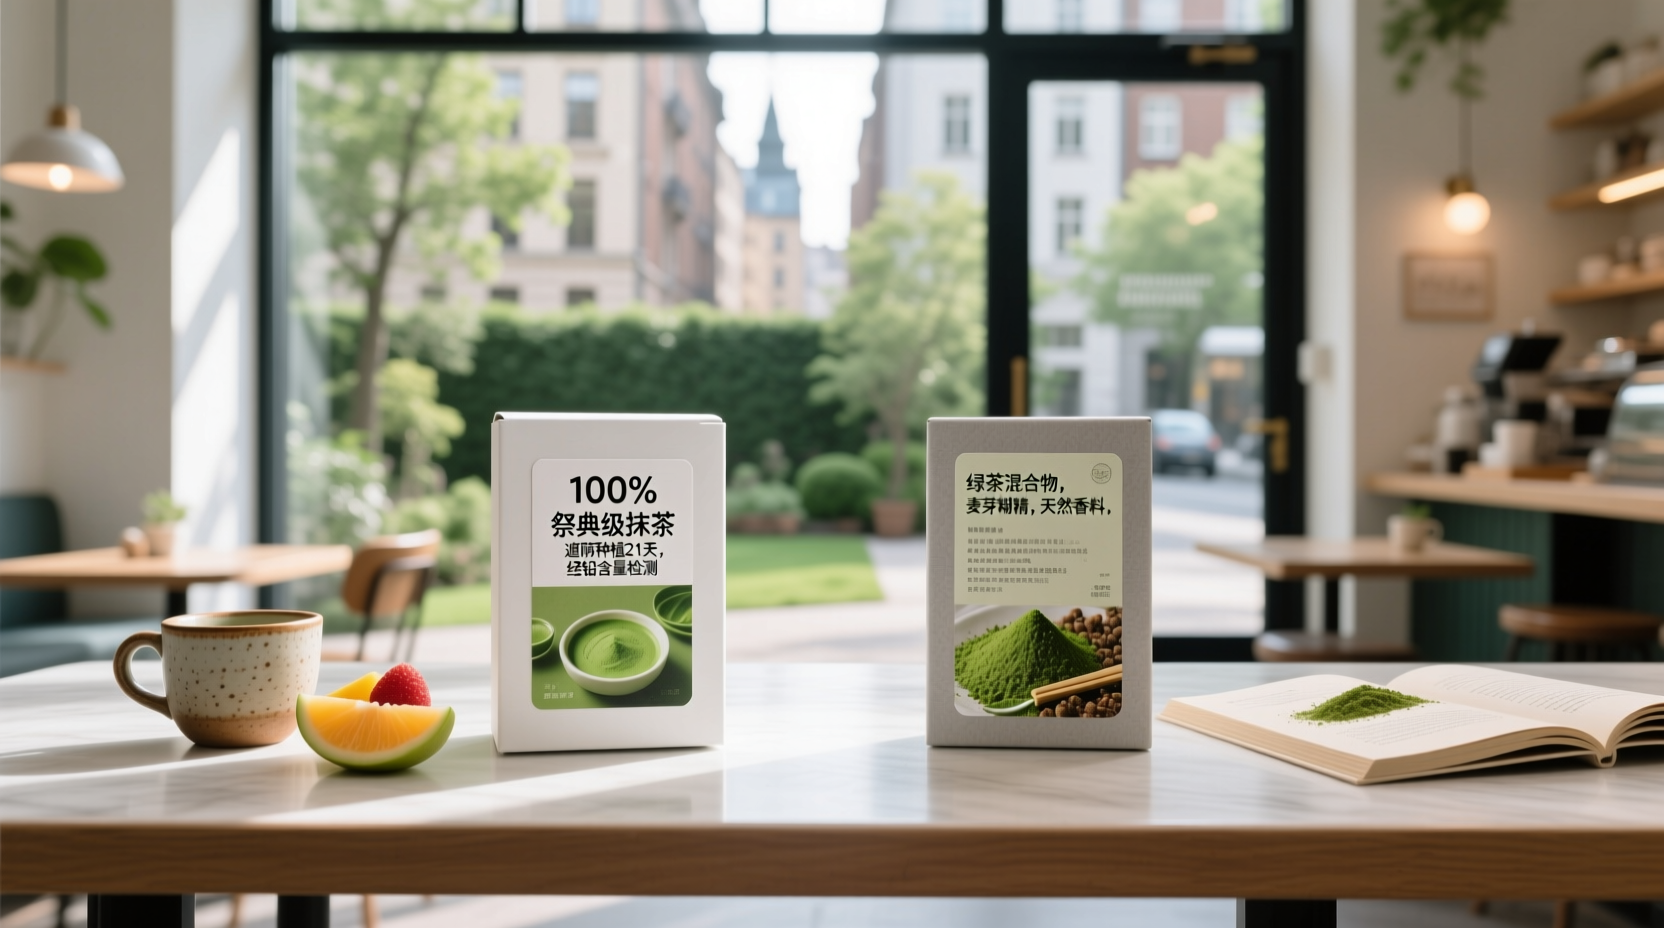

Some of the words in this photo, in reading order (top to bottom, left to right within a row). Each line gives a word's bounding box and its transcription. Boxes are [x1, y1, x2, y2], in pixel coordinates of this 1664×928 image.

[569, 475, 657, 505] 100%
[965, 472, 1065, 494] 绿茶混合物，
[551, 511, 675, 538] 祭典级抹茶
